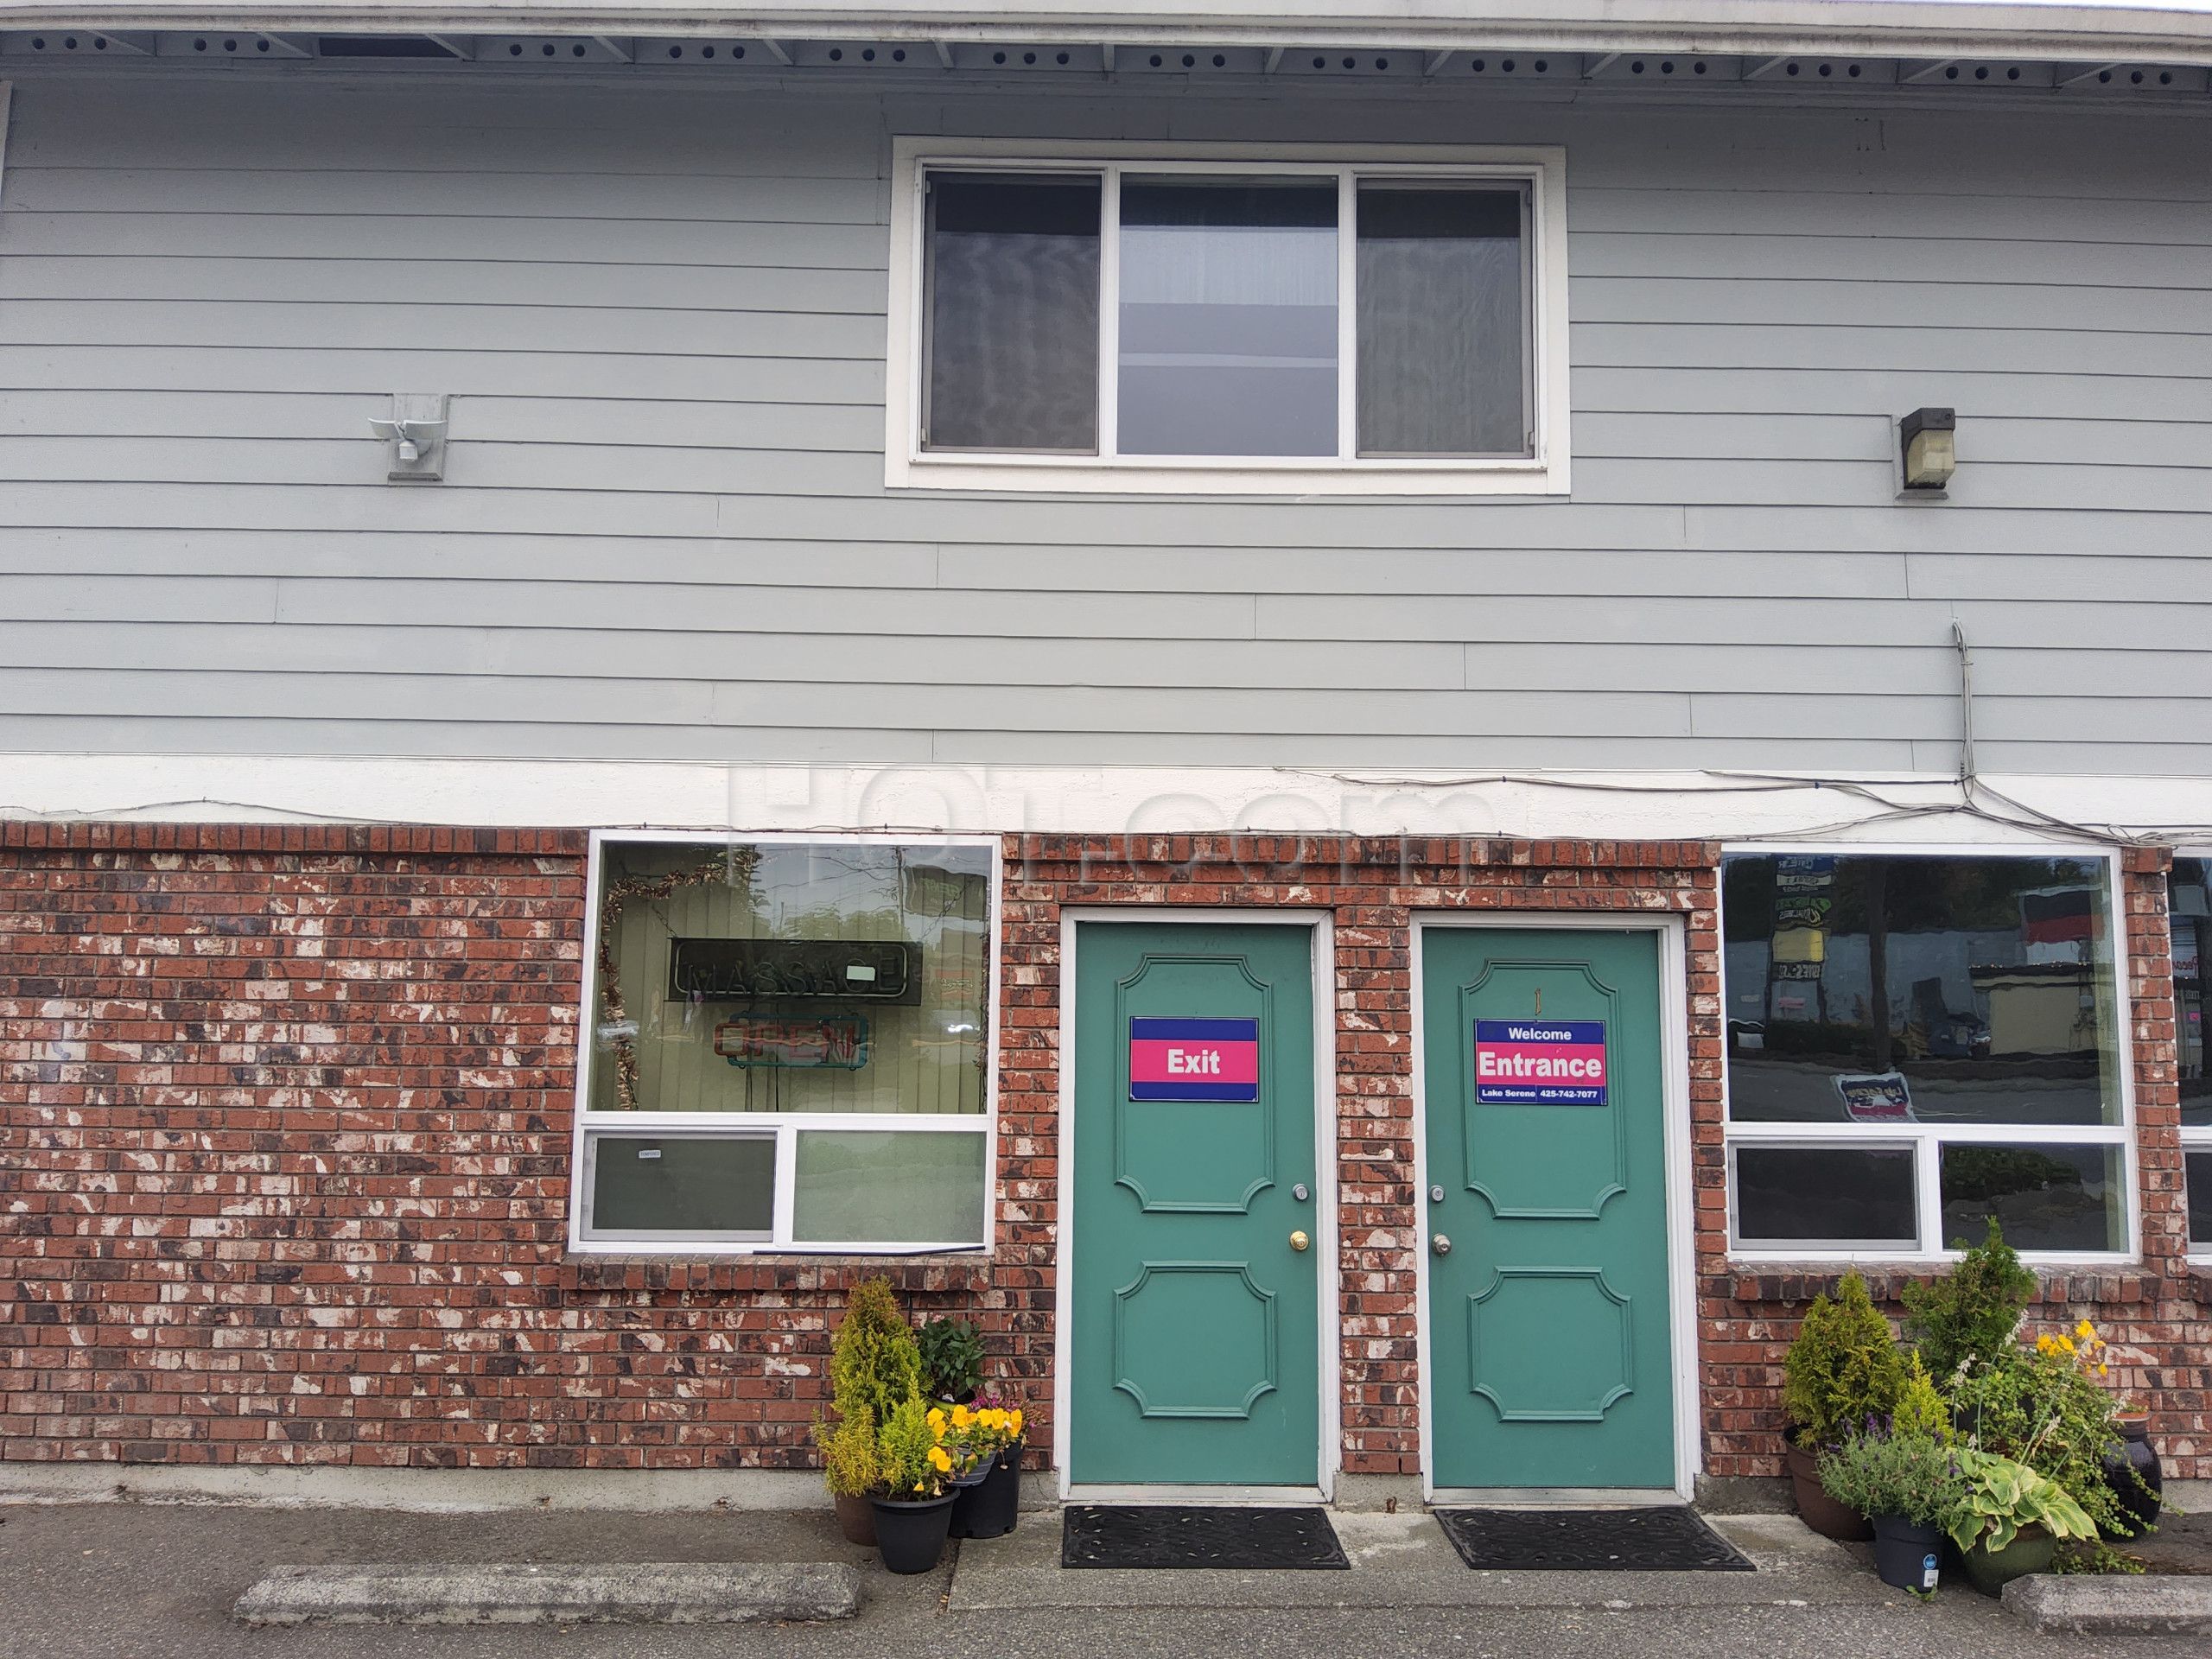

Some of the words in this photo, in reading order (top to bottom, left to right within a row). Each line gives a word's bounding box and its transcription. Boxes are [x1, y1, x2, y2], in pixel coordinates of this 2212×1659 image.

[714, 1023, 855, 1058] OPEN
[1508, 1027, 1572, 1040] Welcome
[1167, 1049, 1221, 1074] Exit
[1478, 1052, 1602, 1077] Entrance
[1505, 1089, 1536, 1097] Serene
[1540, 1090, 1598, 1098] 425-742-7077
